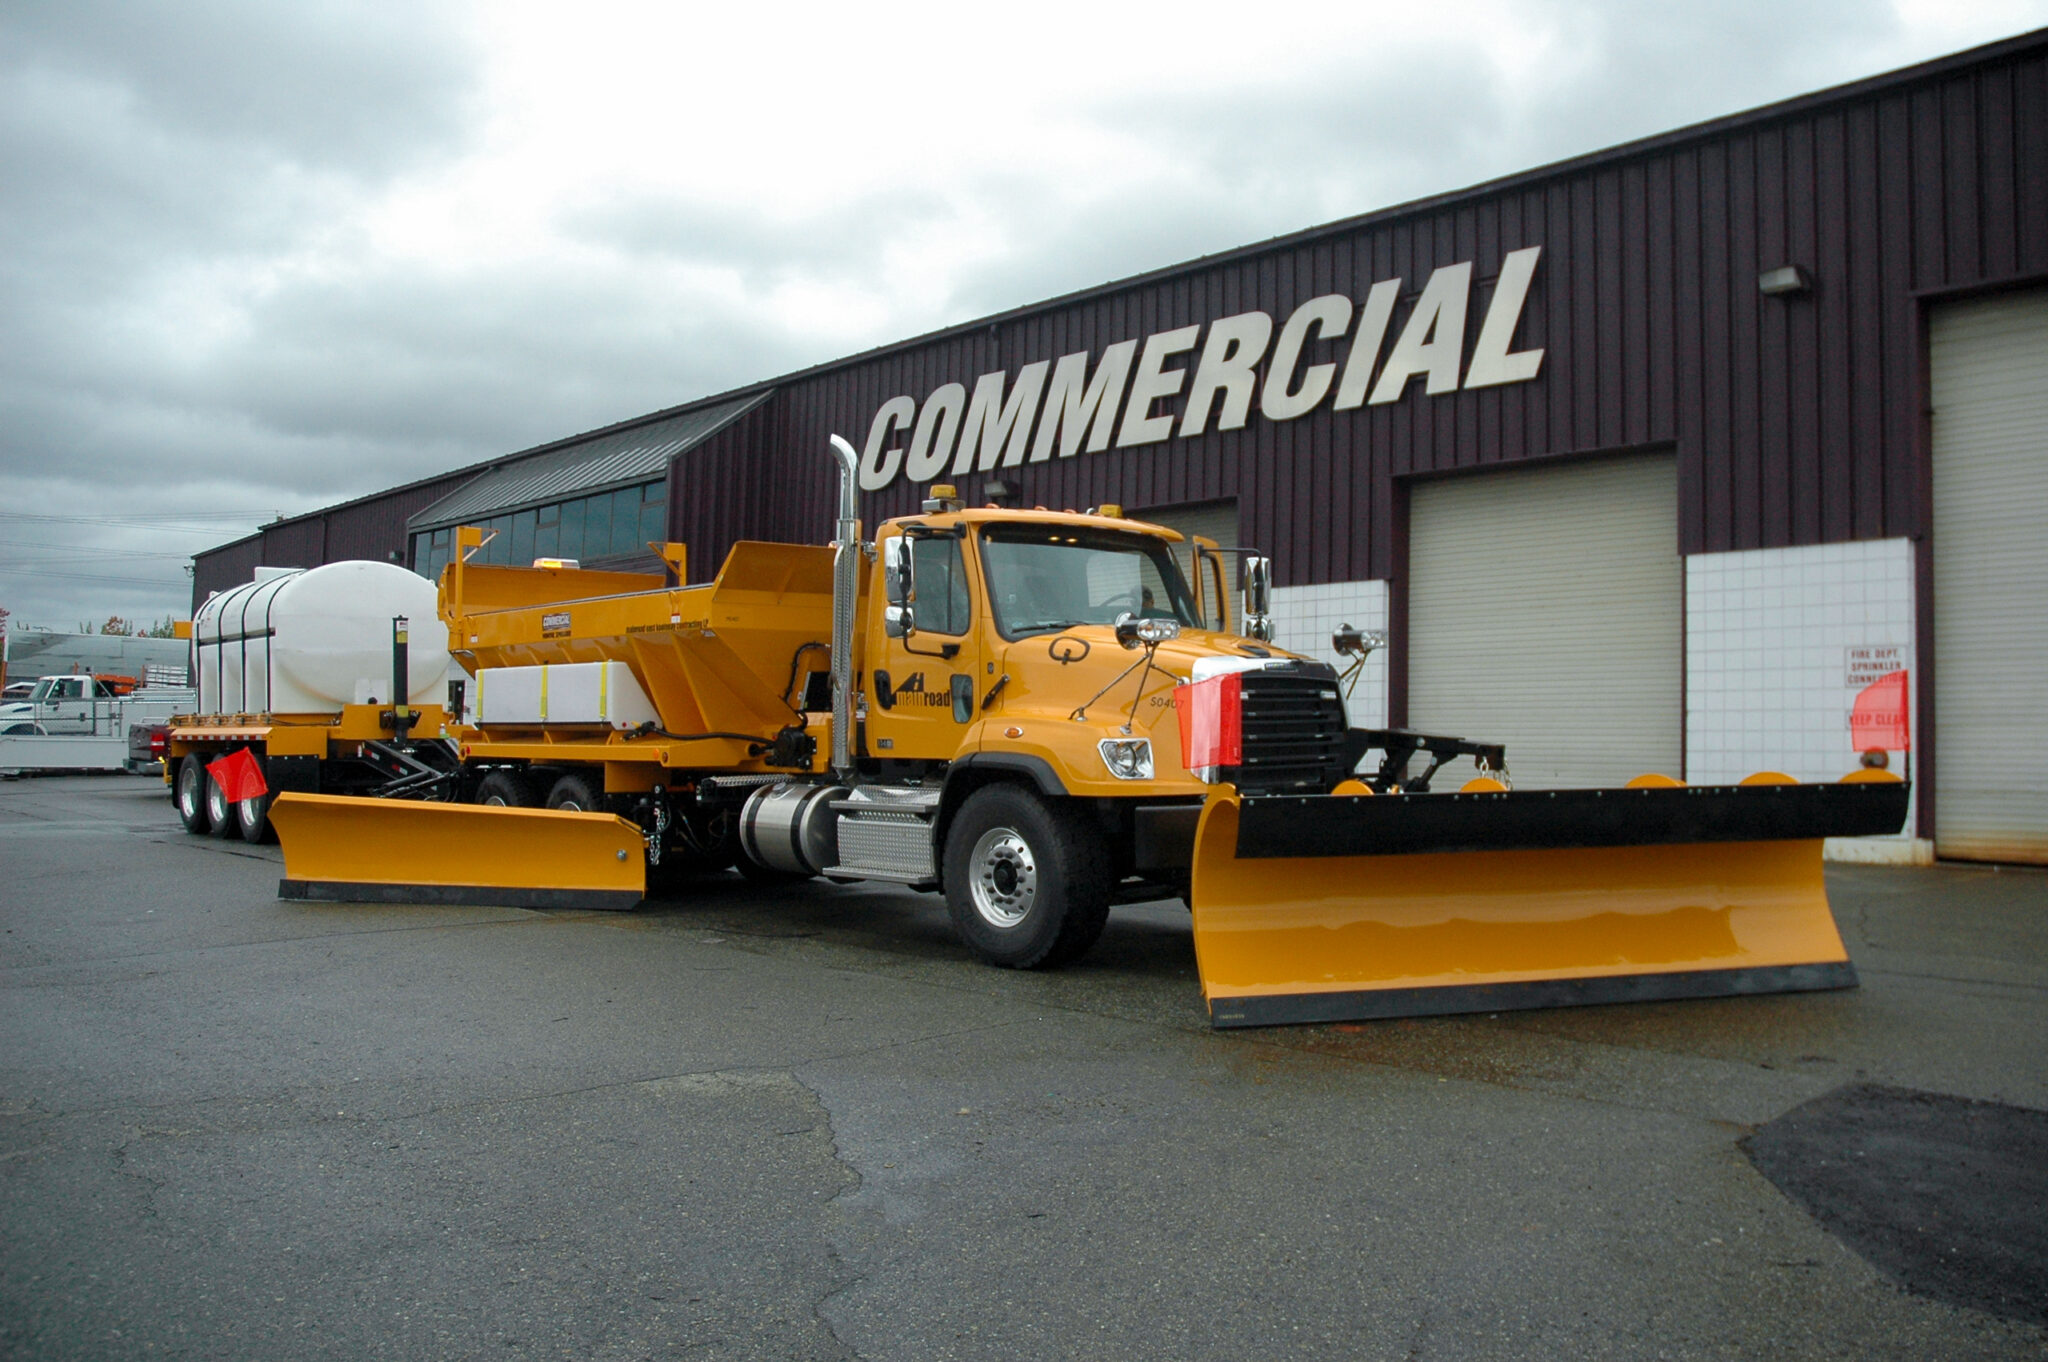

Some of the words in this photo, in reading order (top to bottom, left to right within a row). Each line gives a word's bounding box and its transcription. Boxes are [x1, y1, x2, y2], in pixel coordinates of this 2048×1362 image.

[859, 245, 1545, 491] COMMERCIAL
[1851, 649, 1870, 658] FIRE
[1851, 661, 1901, 671] SPRINKLER
[897, 689, 951, 707] mainroad
[1875, 713, 1905, 725] CLEA
